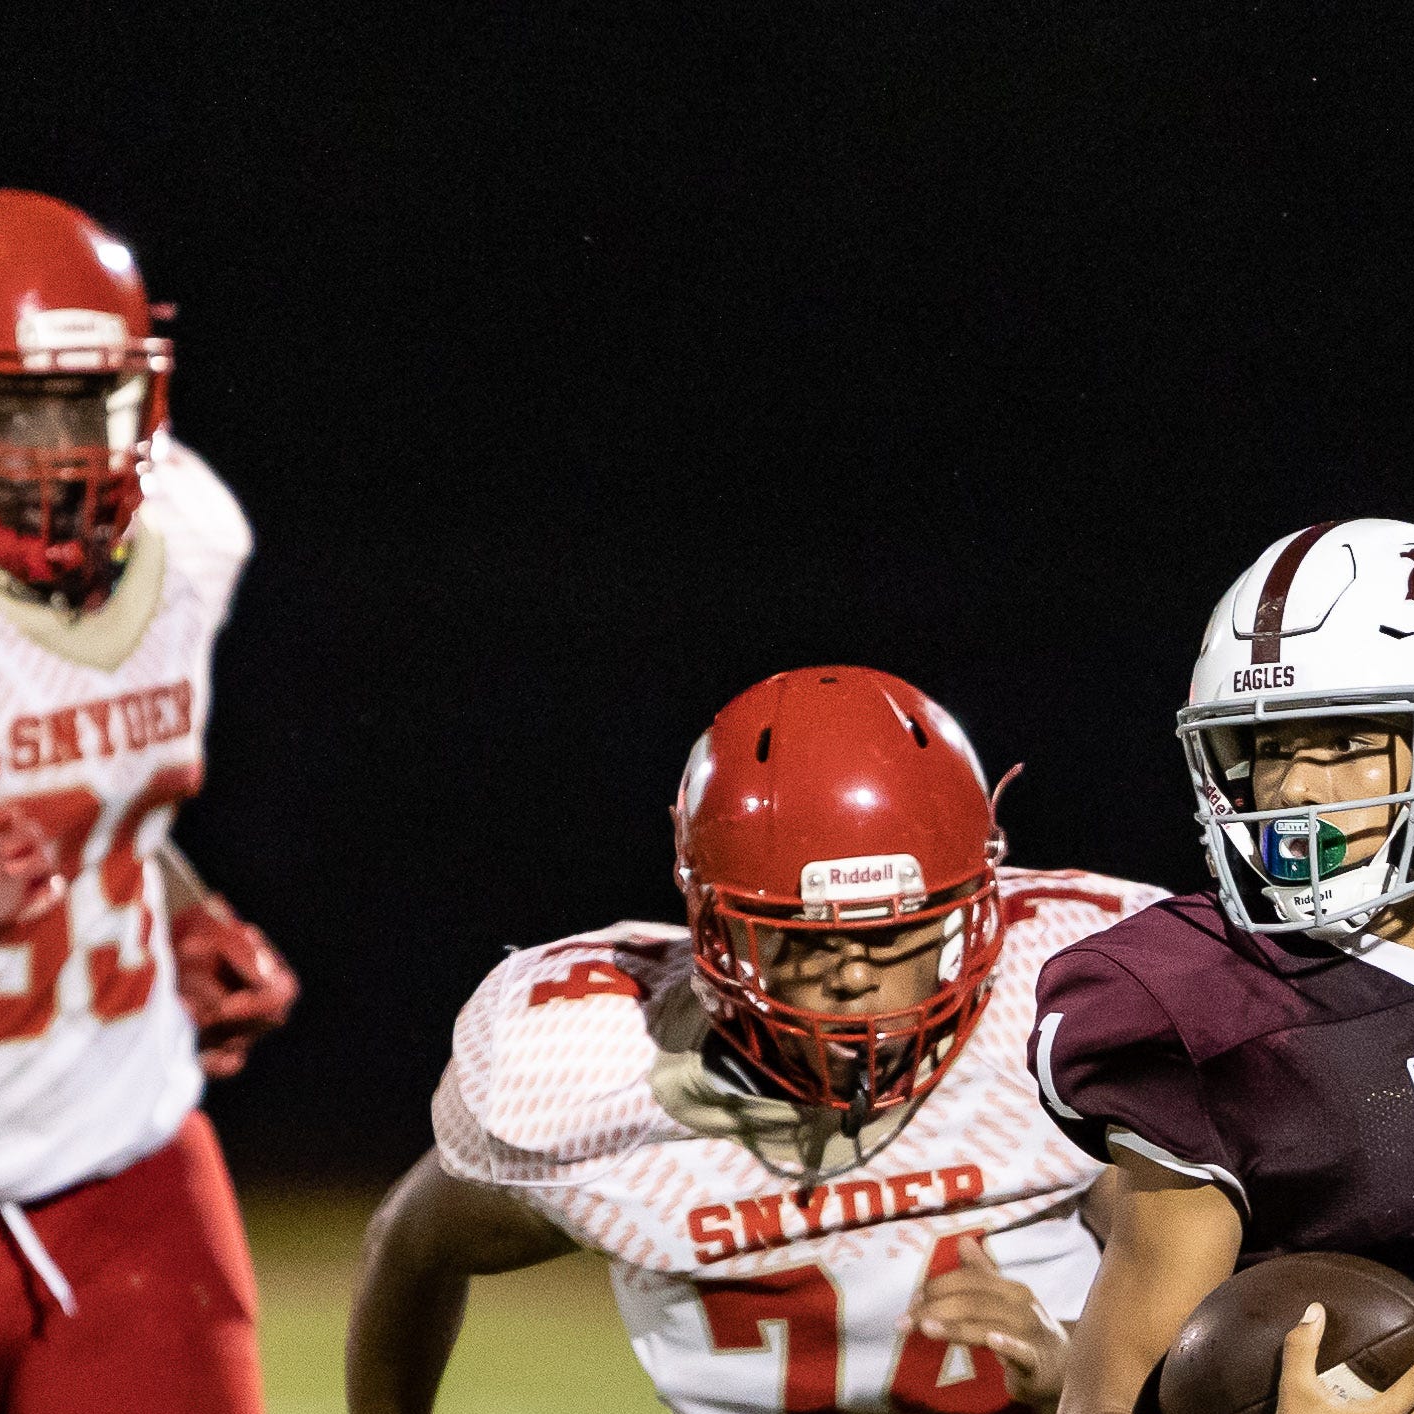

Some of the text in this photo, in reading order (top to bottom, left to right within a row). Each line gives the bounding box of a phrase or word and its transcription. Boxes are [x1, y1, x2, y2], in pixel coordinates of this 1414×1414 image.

[8, 678, 194, 772] SNYDER
[1233, 665, 1295, 693] EAGLES
[829, 864, 894, 885] Riddell
[1037, 1012, 1084, 1120] 1
[687, 1163, 987, 1267] SNYDER
